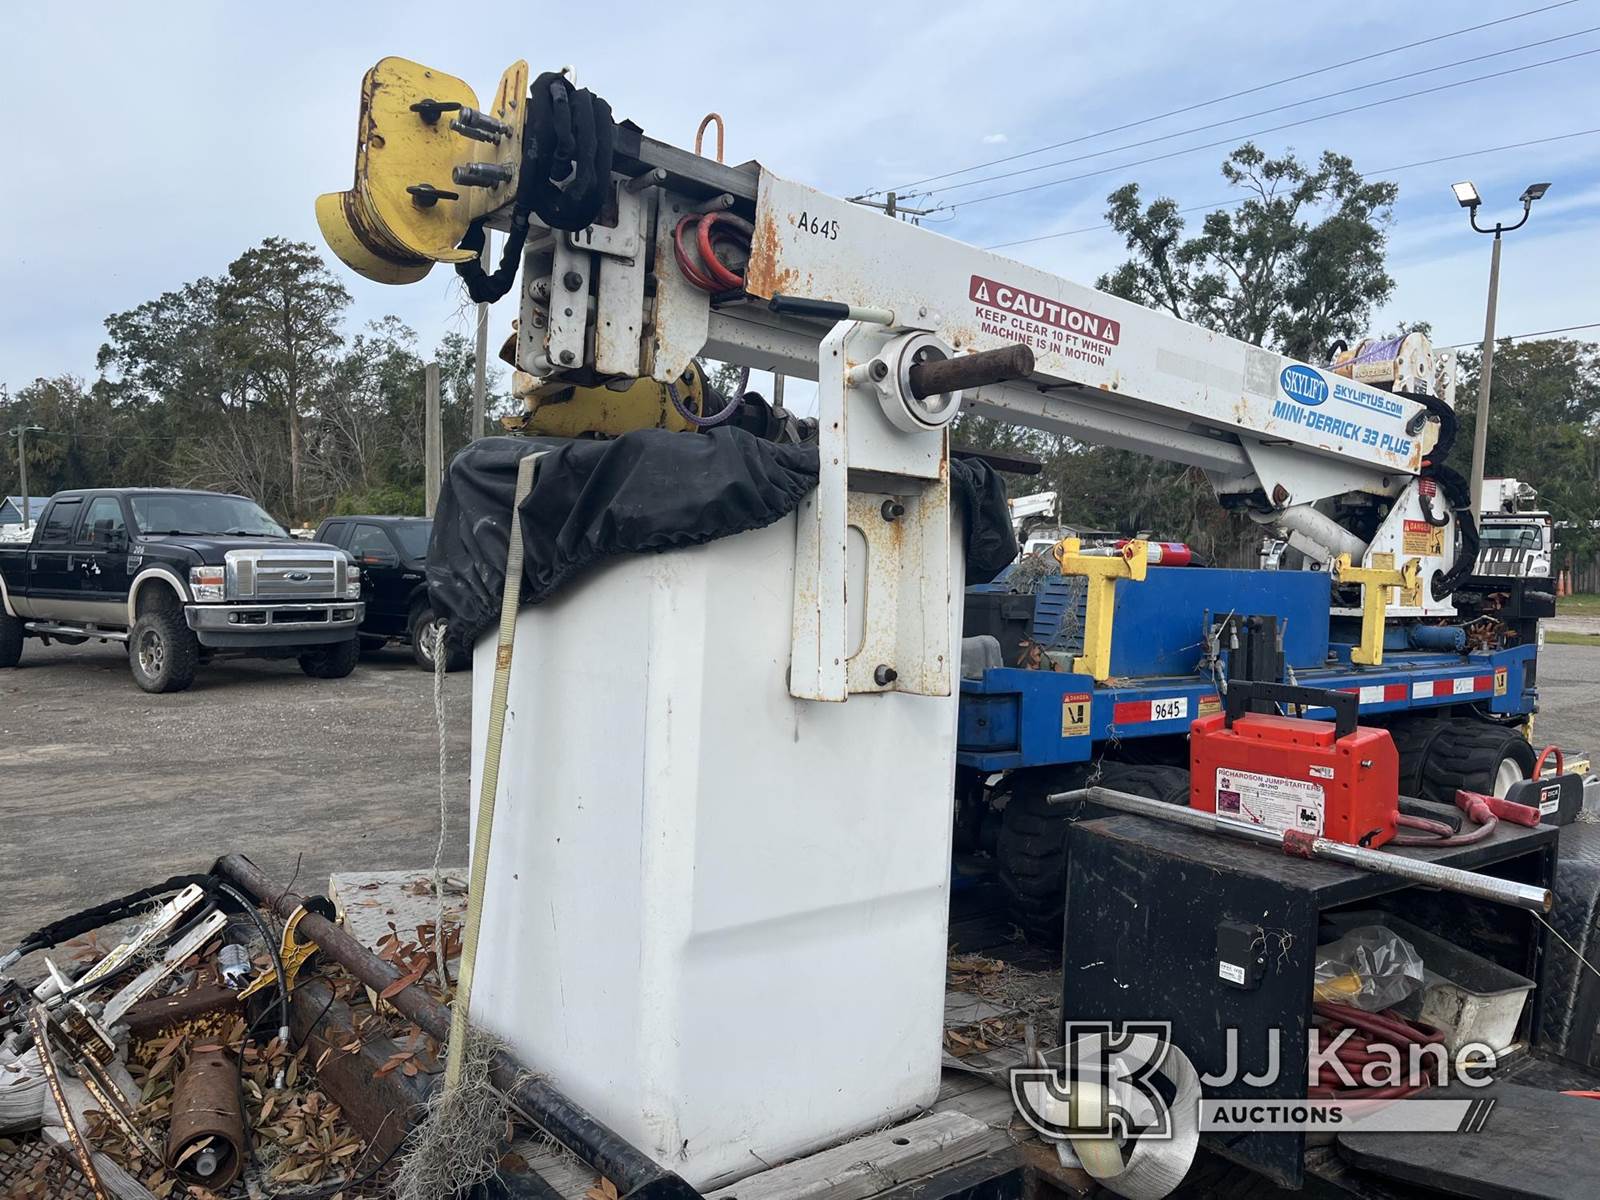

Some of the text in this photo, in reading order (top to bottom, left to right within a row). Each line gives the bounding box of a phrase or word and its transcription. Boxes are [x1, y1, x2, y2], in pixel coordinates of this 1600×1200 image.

[798, 211, 839, 240] A645
[996, 288, 1098, 336] CAUTION
[975, 307, 1112, 356] KEEP CLEAR 10 FT WHEN
[981, 322, 1105, 367] MACHINE IS IN MOTION
[1284, 368, 1327, 402] SKYLIFT
[1333, 383, 1403, 416] SKYLIFTUS.COM
[1272, 400, 1411, 456] MINI-DERRICK 33 PLUS
[1155, 701, 1180, 719] 9645
[1218, 769, 1321, 792] RICHARDSON JUMPSTARTERS
